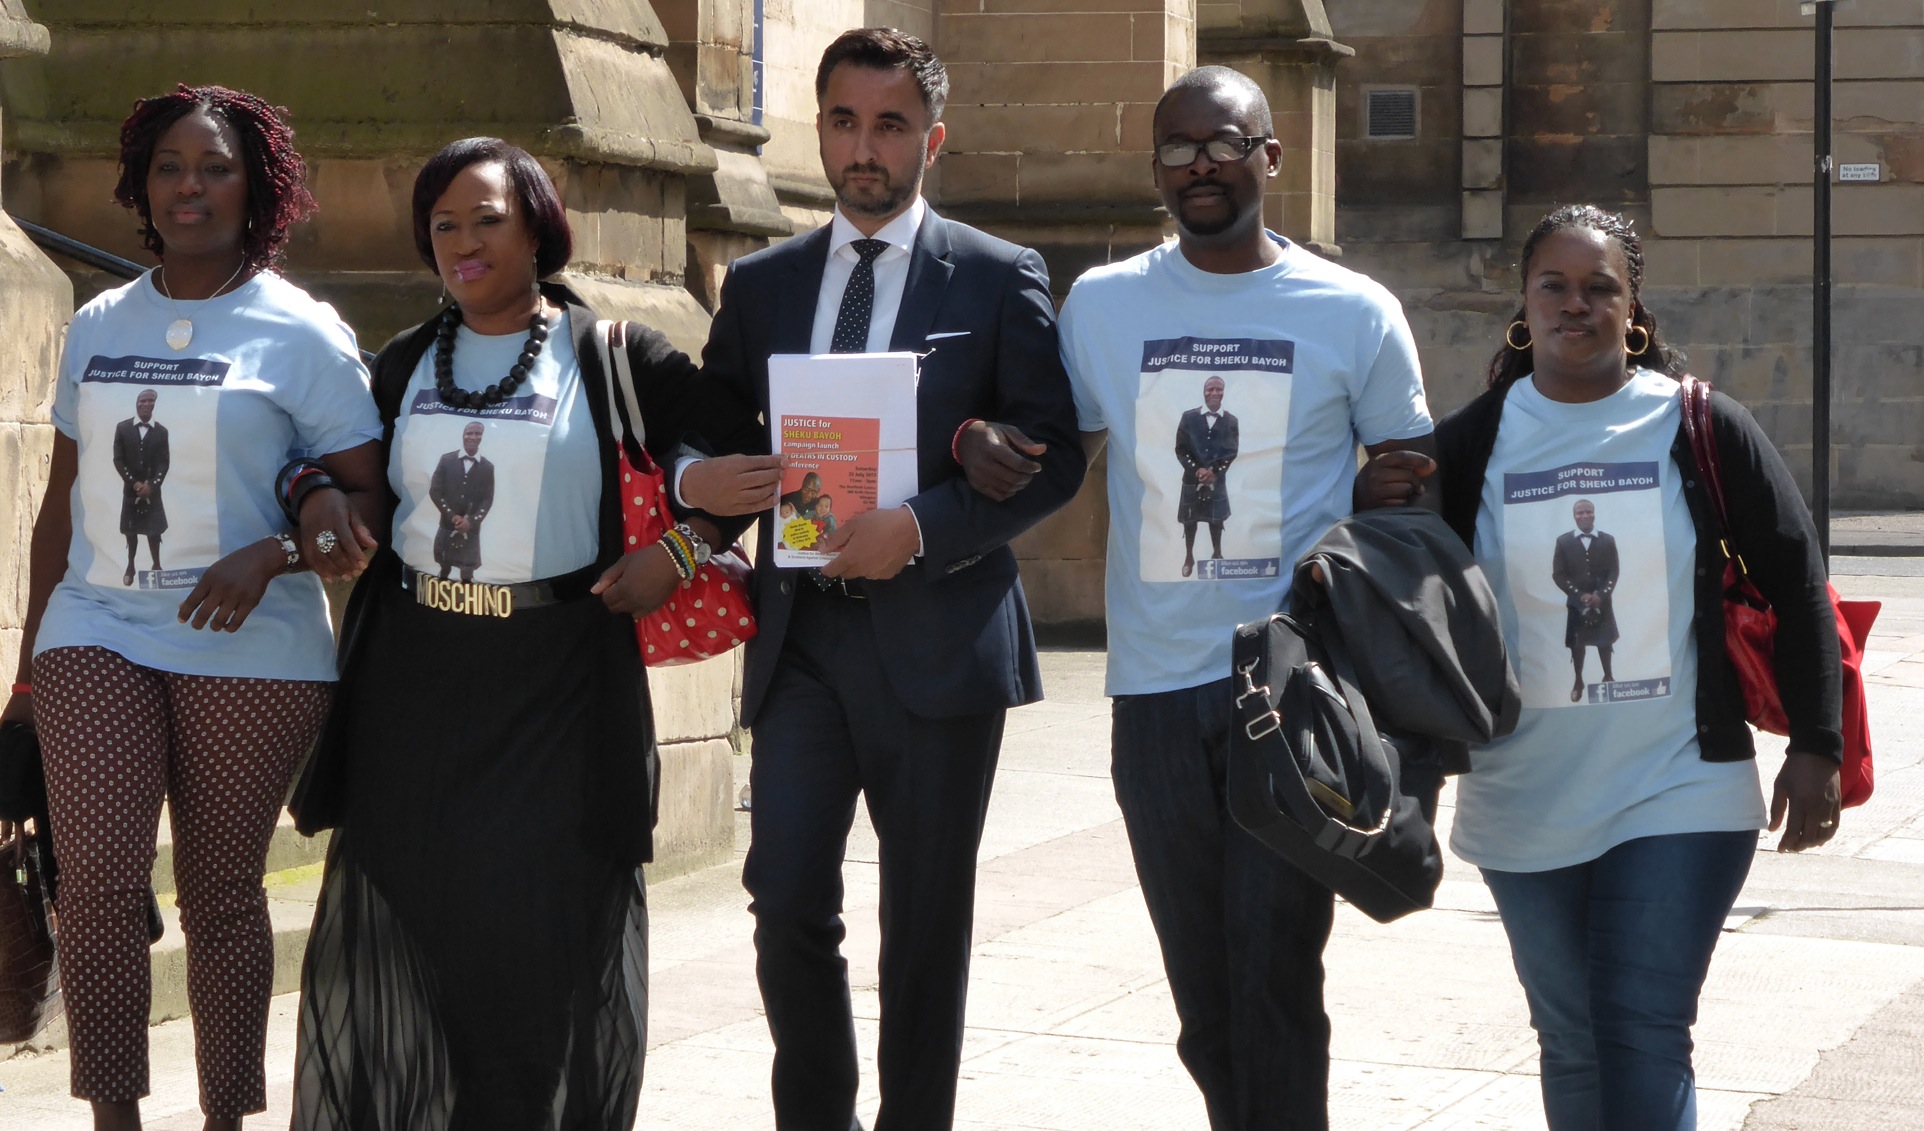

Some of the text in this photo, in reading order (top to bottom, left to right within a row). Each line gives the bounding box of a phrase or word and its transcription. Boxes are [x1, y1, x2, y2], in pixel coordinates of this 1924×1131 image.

[1192, 343, 1240, 353] SUPPORT
[133, 360, 180, 371] SUPPORT
[1148, 354, 1287, 367] JUSTICE FOR SHEKU BAYOH
[88, 369, 219, 382] JUSTICE FOR SHEKU BAYOH
[416, 401, 455, 412] JUSTICE
[457, 407, 478, 415] FOR
[479, 408, 512, 416] SHEKU
[514, 408, 548, 420] BAYOH
[783, 418, 831, 428] JUSTICE for
[783, 430, 842, 440] SHEKU BAYOH
[783, 442, 816, 450] campaign
[826, 453, 858, 462] CUSTODY
[788, 461, 820, 469] nference
[1557, 467, 1605, 480] SUPPORT
[1511, 476, 1654, 499] JUSTICE FOR SHEKU BAYOH
[1221, 566, 1259, 576] facebook
[161, 575, 199, 586] facebook
[416, 572, 512, 618] MOSCHINO
[1613, 687, 1650, 698] facebook
